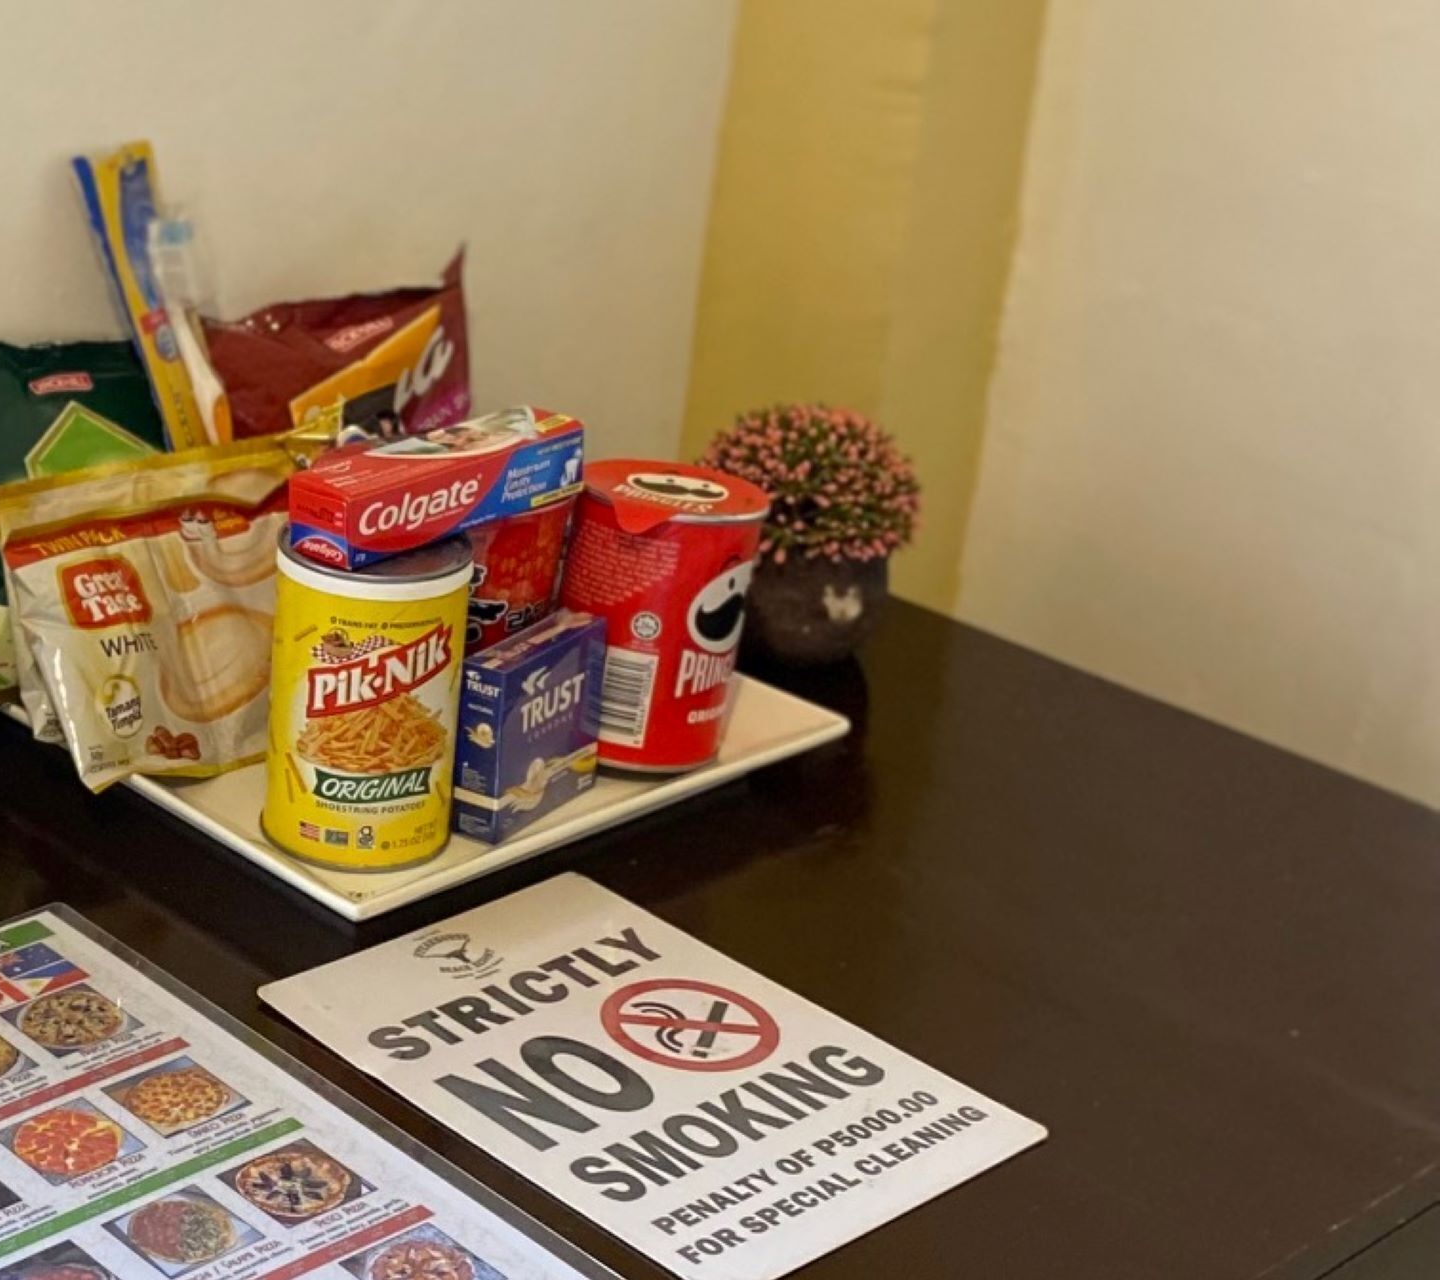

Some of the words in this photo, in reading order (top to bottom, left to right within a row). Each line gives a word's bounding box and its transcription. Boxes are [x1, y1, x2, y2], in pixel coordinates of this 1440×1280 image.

[358, 479, 479, 536] Colgate
[32, 535, 82, 557] TWIN
[303, 541, 343, 562] Colgate
[101, 631, 160, 658] WHITE
[466, 679, 501, 698] TRUST
[521, 672, 585, 733] TRUST
[316, 800, 378, 815] SHOESTRING
[381, 800, 426, 814] POTATOES
[321, 771, 426, 802] ORIGINAL
[368, 928, 659, 1059] STRICTLY
[434, 1035, 653, 1150] NO
[570, 1045, 884, 1201] SMOKING
[651, 1168, 777, 1234] PENALTY
[775, 1149, 814, 1174] OF
[812, 1091, 937, 1156] P5000.00
[676, 1228, 746, 1264] FOR
[739, 1173, 861, 1233] SPECIAL
[854, 1106, 987, 1175] CLEANING
[253, 1240, 281, 1253] PIZZA
